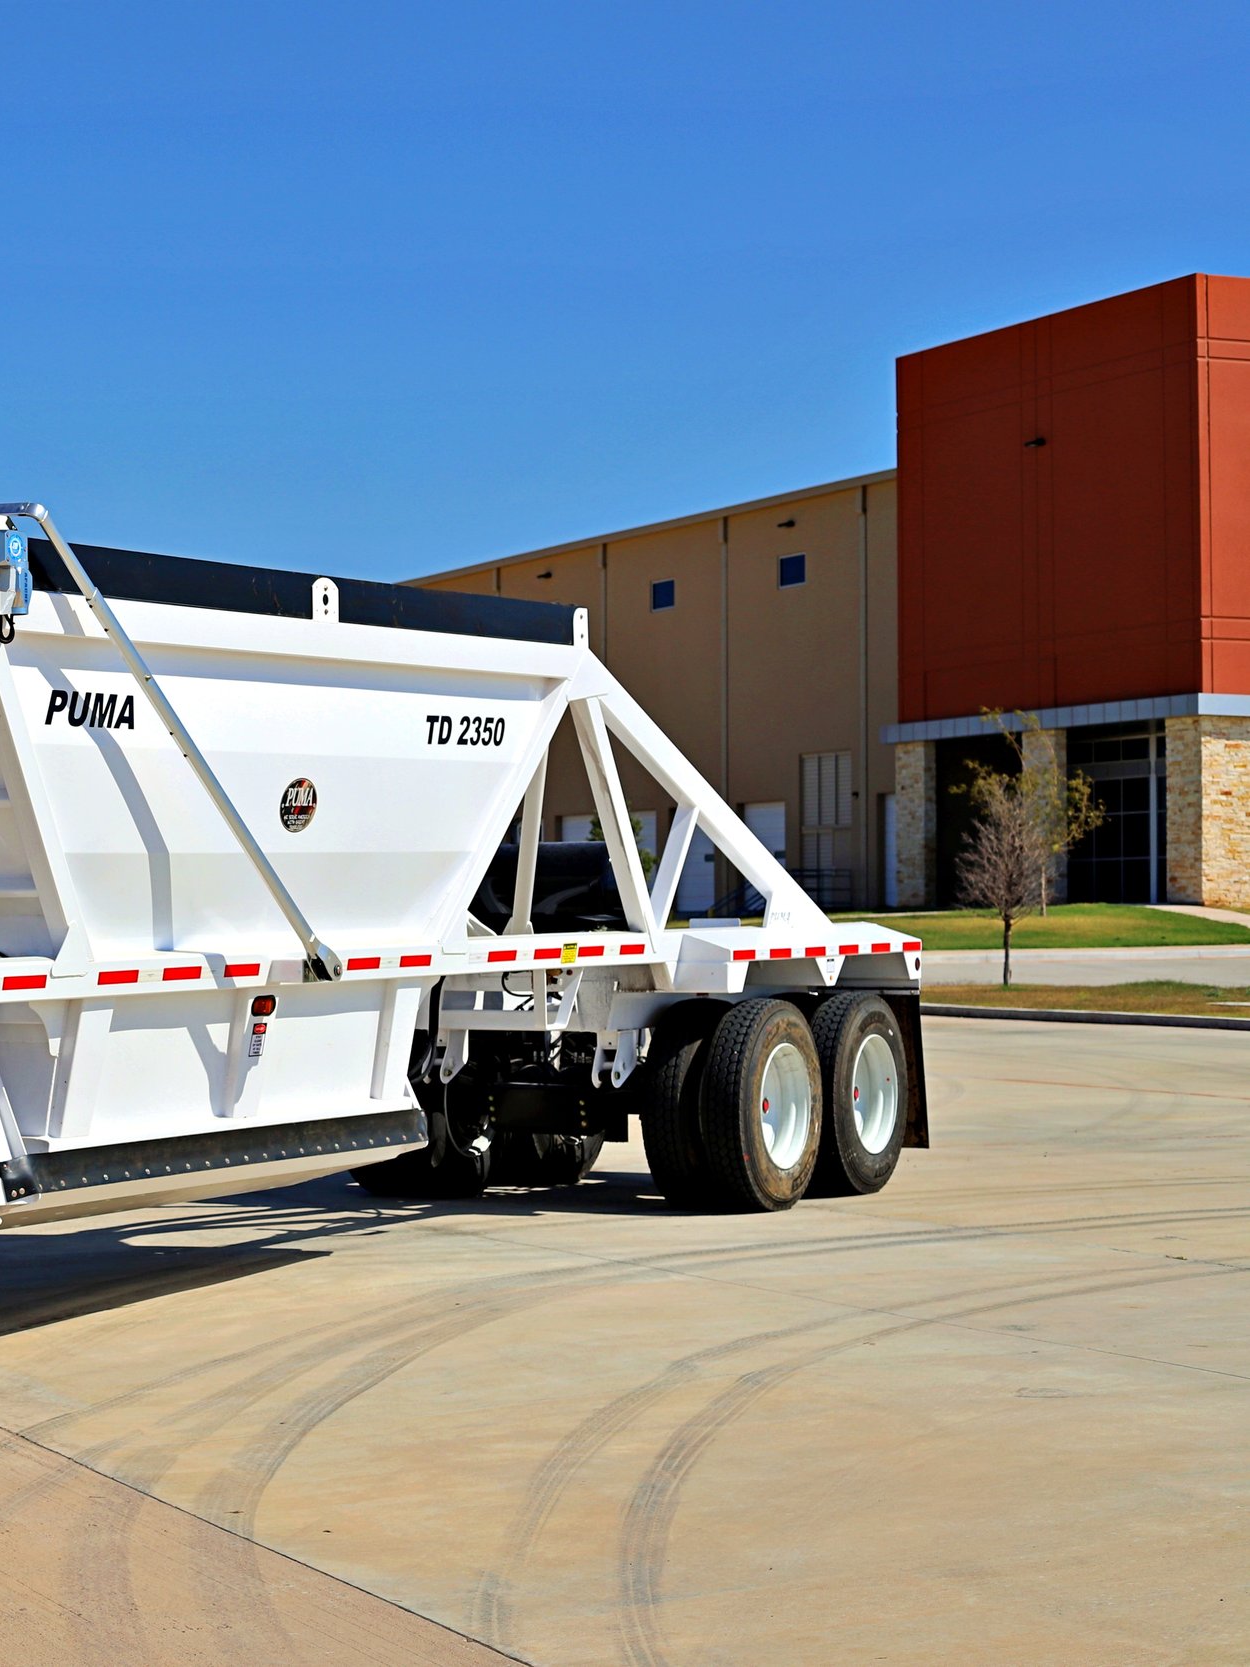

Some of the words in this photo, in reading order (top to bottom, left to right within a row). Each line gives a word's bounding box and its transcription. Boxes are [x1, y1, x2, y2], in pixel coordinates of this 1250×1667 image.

[45, 689, 134, 730] PUMA
[426, 715, 452, 745] TD
[456, 715, 505, 747] 2350
[286, 787, 313, 807] PUMA
